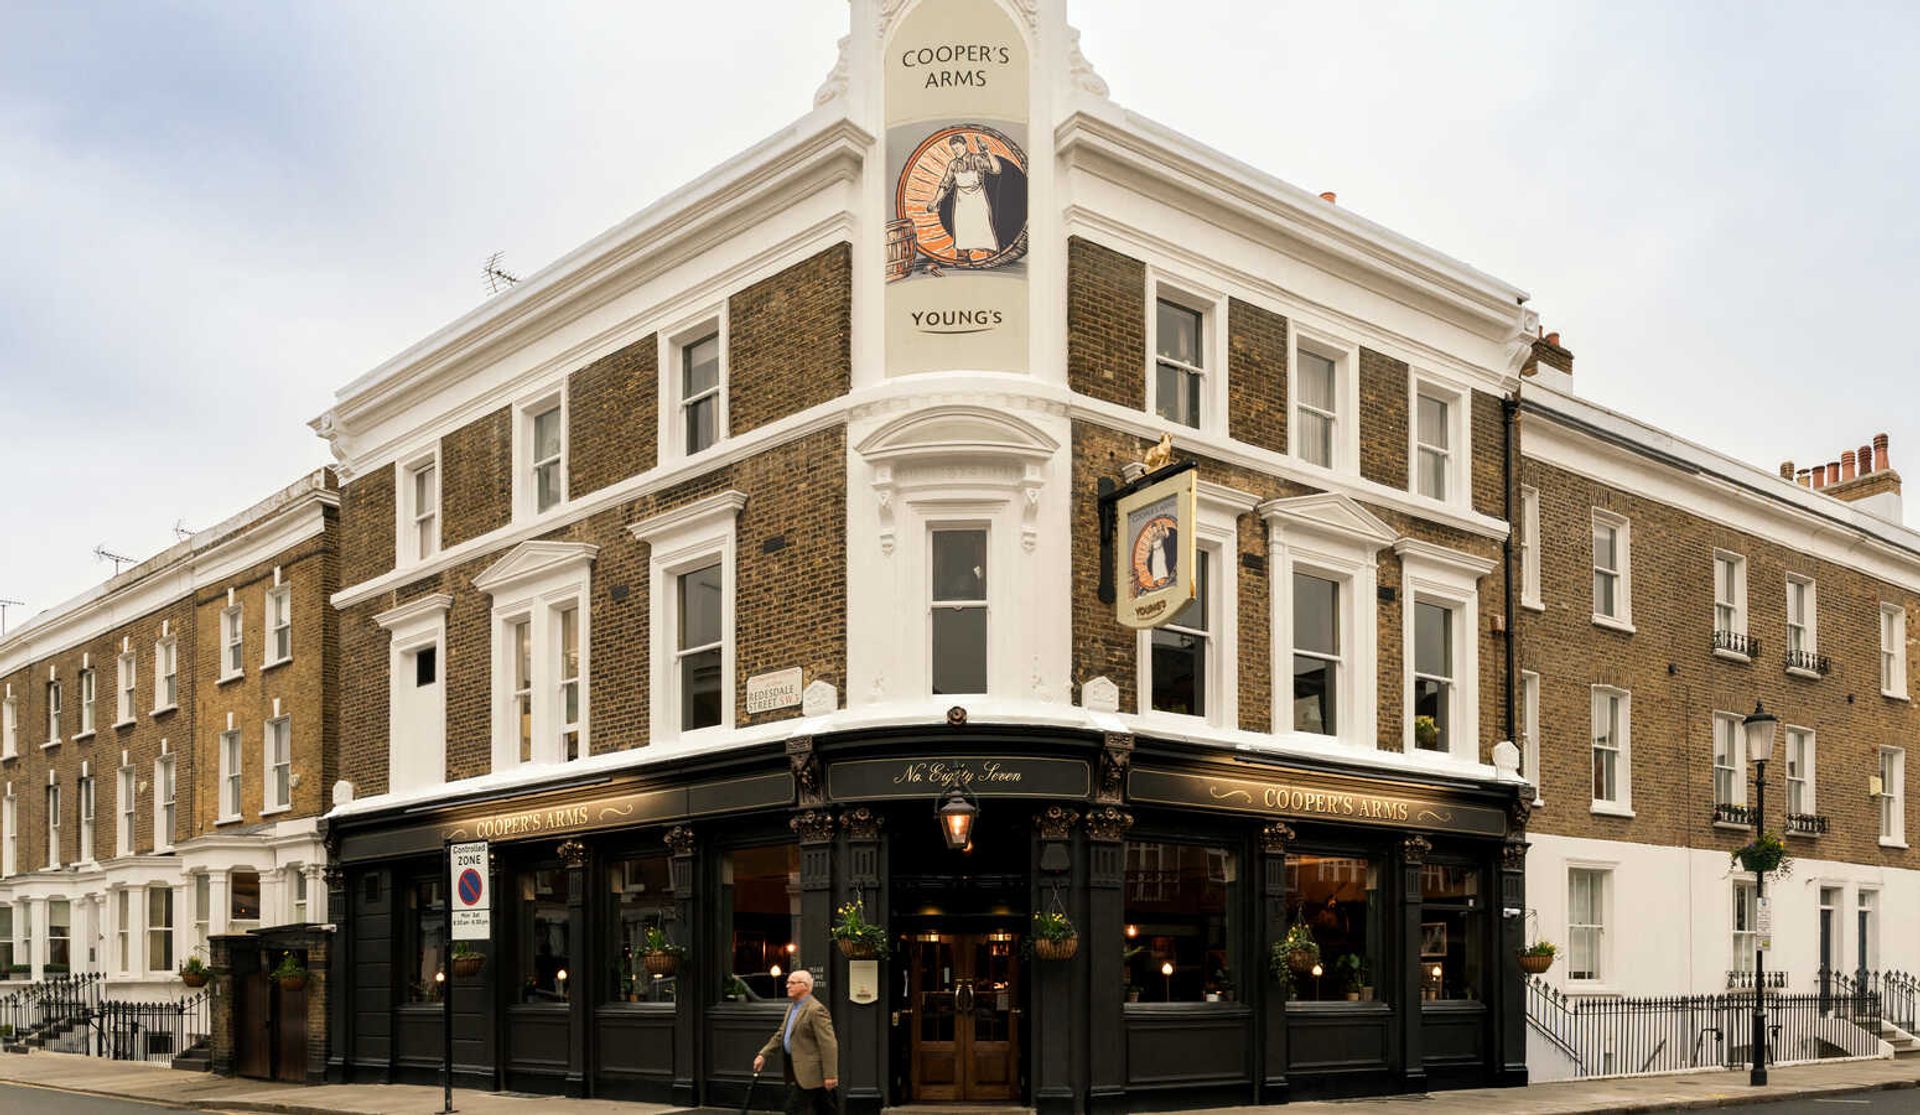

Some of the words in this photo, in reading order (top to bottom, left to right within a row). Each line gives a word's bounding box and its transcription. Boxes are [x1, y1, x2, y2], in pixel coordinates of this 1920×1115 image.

[902, 44, 1010, 68] COOPER'S
[925, 69, 987, 89] ARMS
[911, 309, 1003, 327] YOUNG'S
[749, 684, 794, 701] REDESDALE
[748, 698, 777, 711] STREET
[893, 762, 926, 783] No.
[977, 761, 1022, 783] Seven
[1264, 788, 1354, 815] COOPER'S
[1358, 801, 1409, 822] ARMS
[476, 813, 542, 838] COOPER'S
[545, 806, 588, 829] ARMS
[453, 844, 486, 854] Controlled
[458, 854, 481, 866] ZONE
